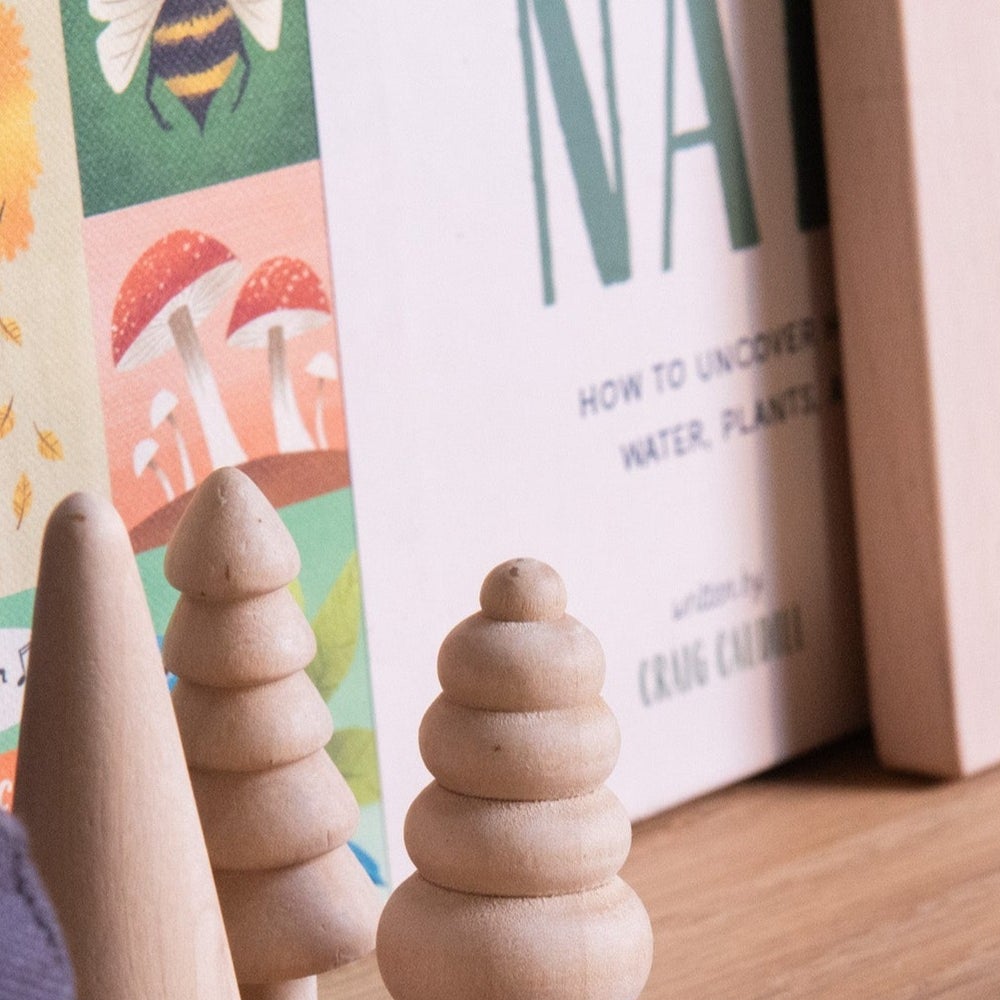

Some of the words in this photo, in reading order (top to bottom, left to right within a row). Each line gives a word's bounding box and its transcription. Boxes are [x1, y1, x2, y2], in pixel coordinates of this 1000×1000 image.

[515, 0, 832, 306] NA
[578, 370, 644, 418] HOW
[652, 358, 687, 393] TO
[694, 317, 816, 383] UNCOVER
[619, 418, 712, 471] WATER,
[638, 637, 709, 707] CRAIG
